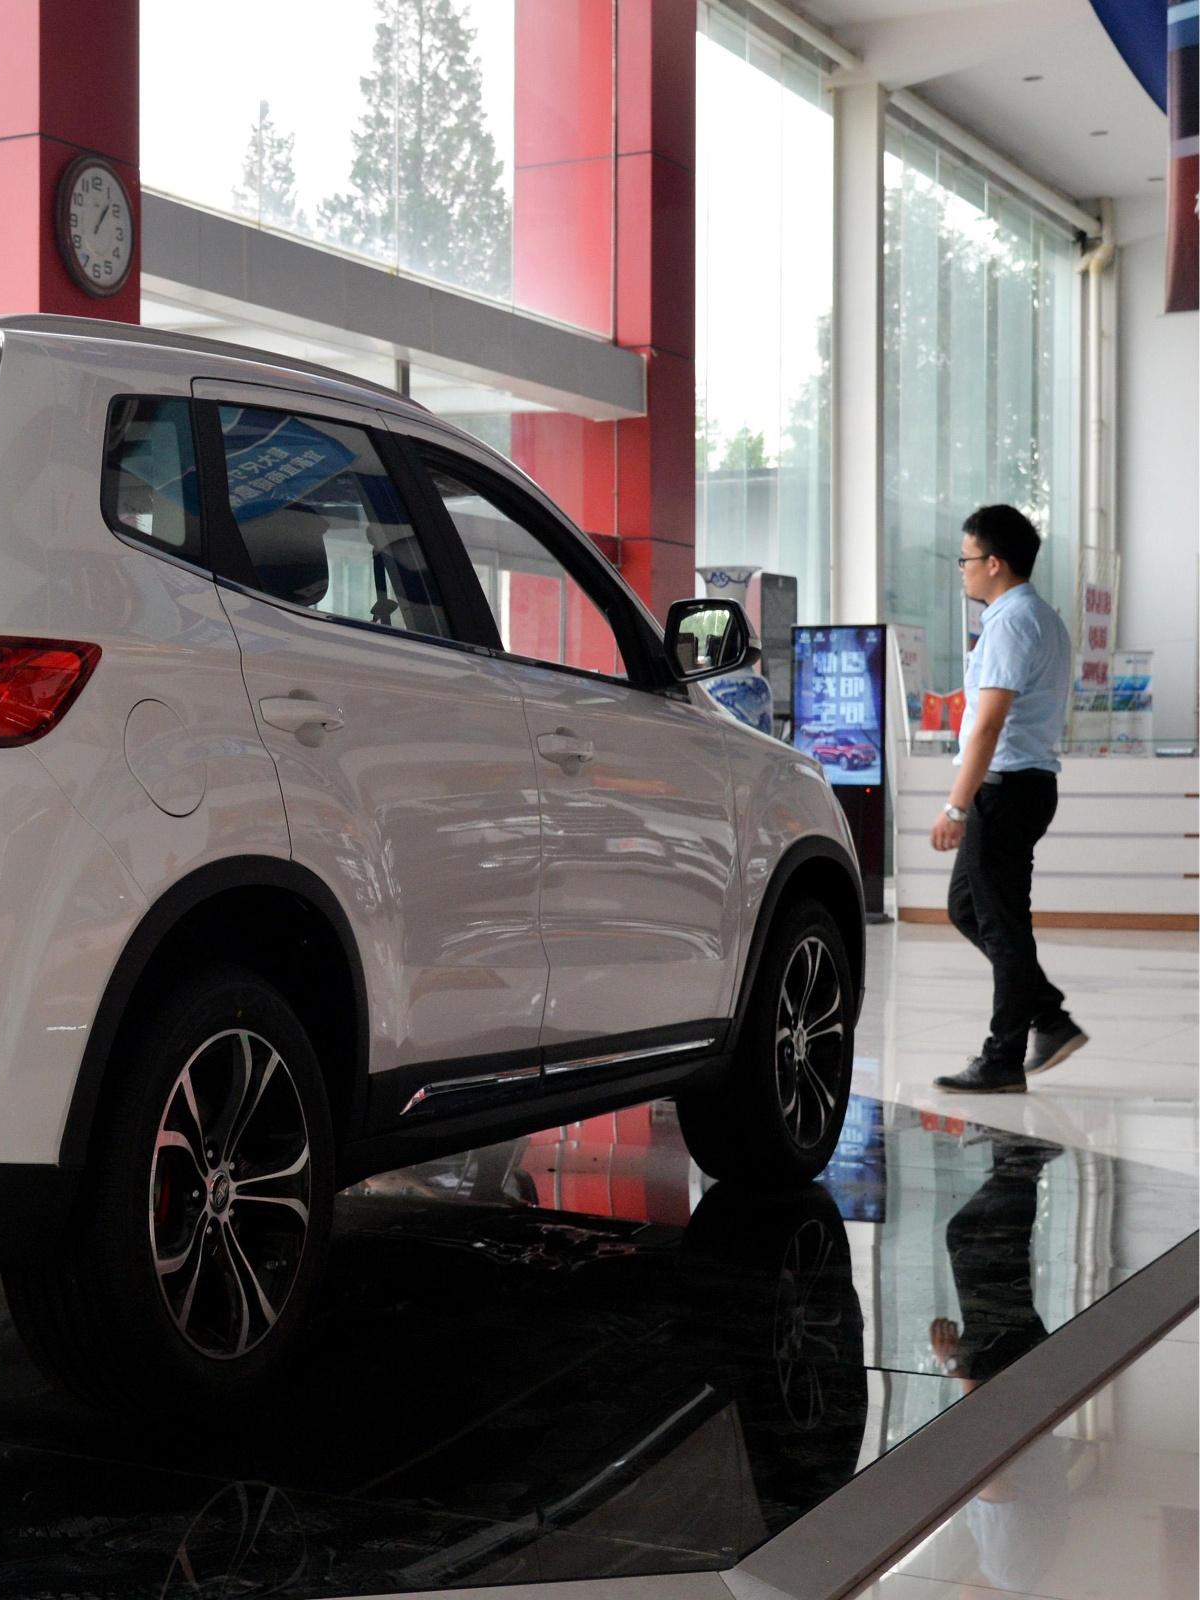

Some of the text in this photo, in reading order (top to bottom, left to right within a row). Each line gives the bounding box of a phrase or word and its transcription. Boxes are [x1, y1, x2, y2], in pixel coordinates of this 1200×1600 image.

[82, 179, 89, 194] 11
[93, 176, 103, 191] 12
[73, 192, 84, 207] 10
[112, 204, 121, 218] 2
[73, 235, 81, 248] 8
[116, 227, 124, 242] 3
[113, 248, 120, 260] 4
[93, 264, 101, 278] 6
[105, 260, 113, 275] 5
